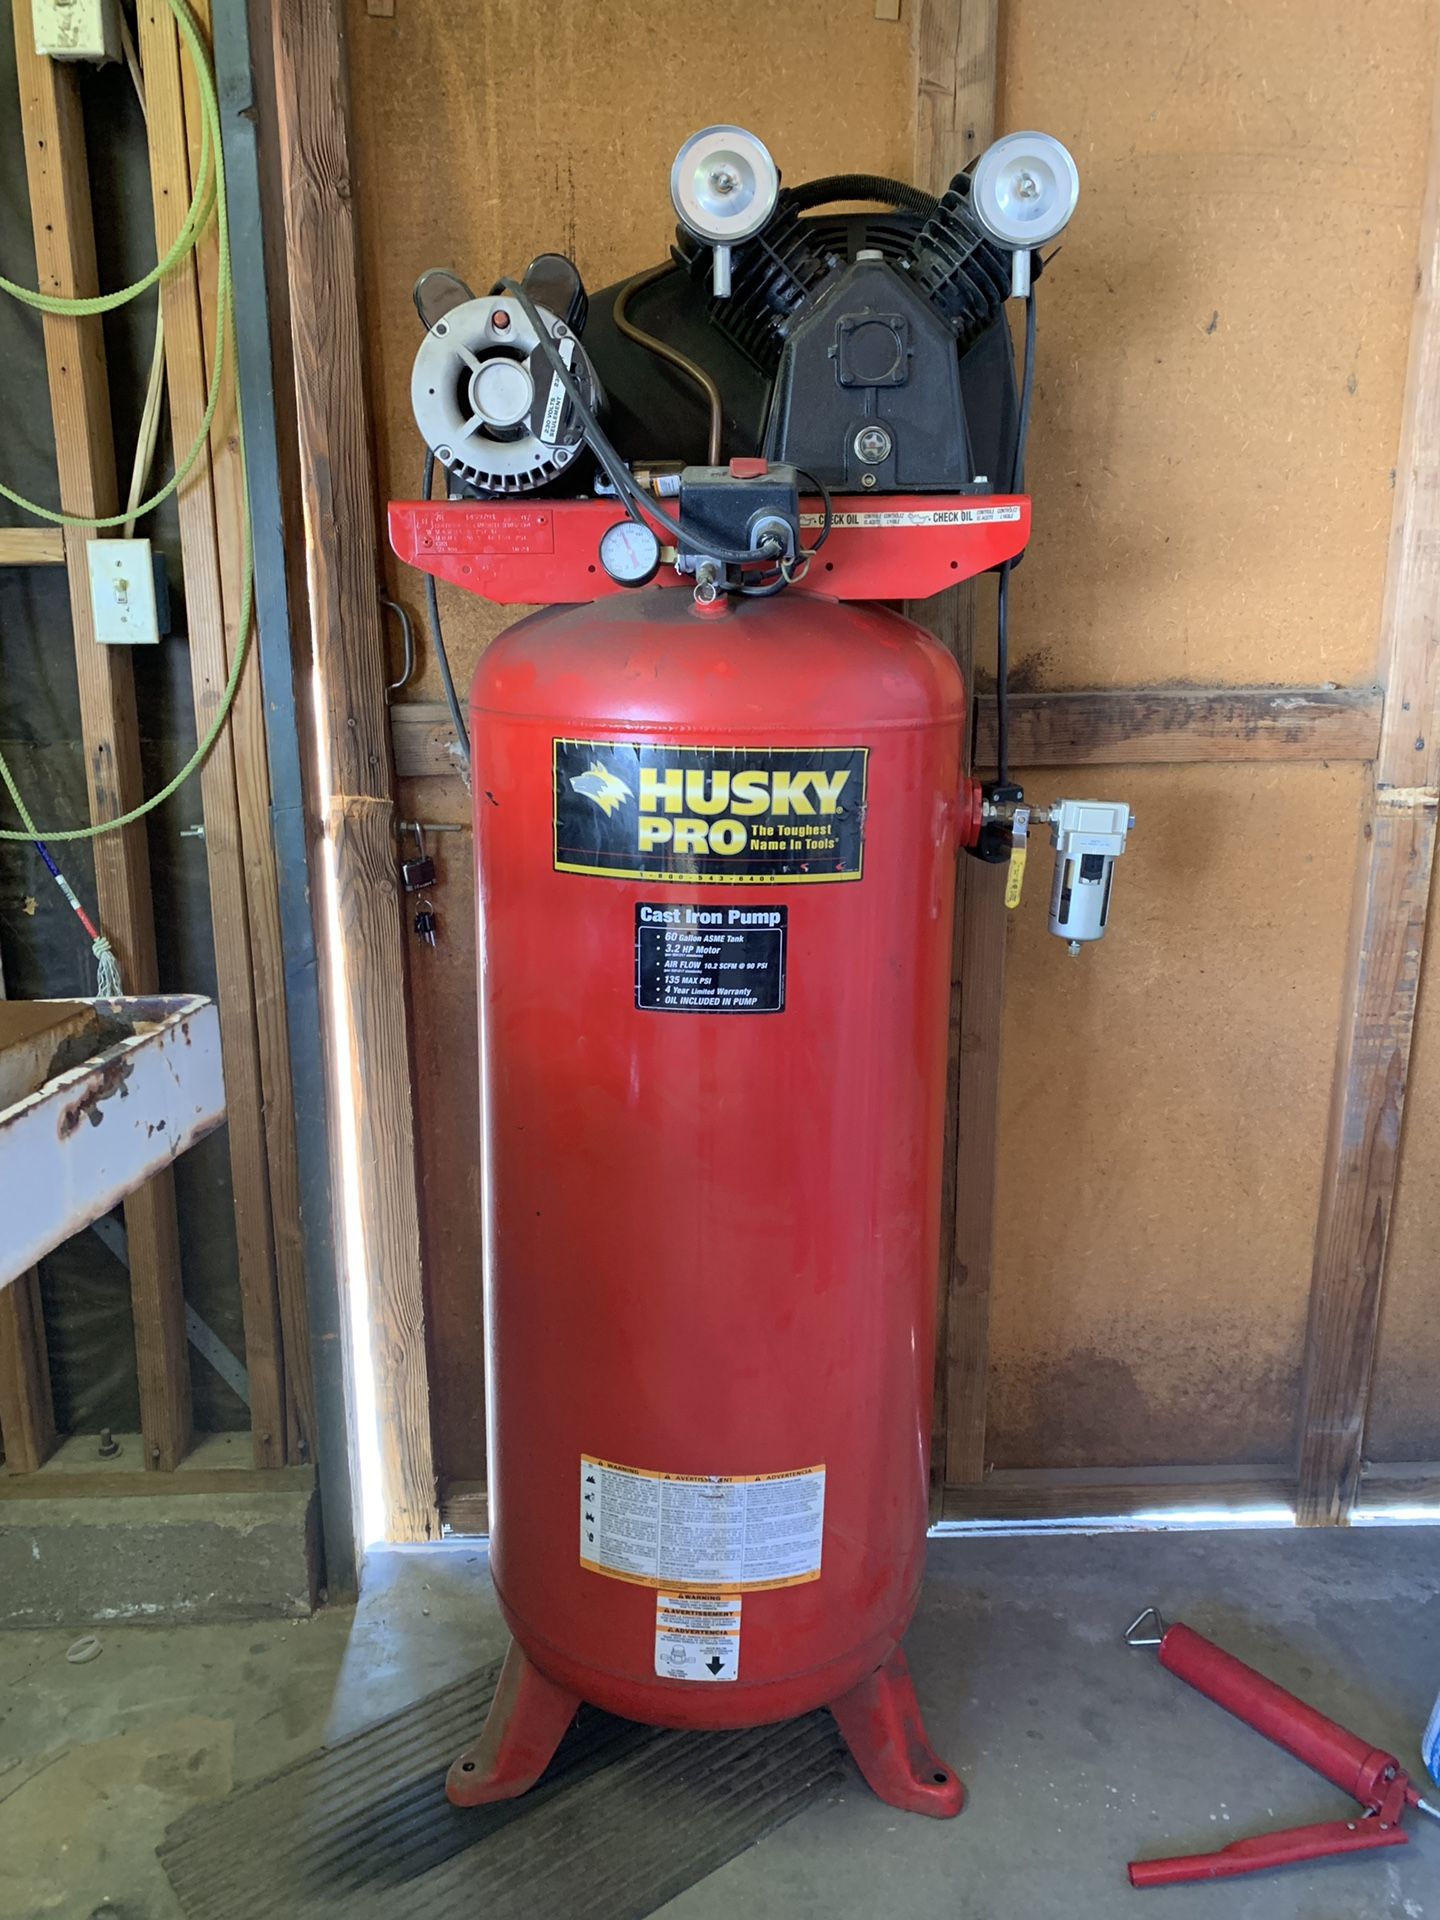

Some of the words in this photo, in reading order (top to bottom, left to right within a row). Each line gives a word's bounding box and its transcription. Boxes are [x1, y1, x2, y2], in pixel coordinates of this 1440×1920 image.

[547, 398, 555, 418] VOLTS
[549, 397, 561, 437] SEULEMENT
[819, 514, 844, 524] CECK
[846, 514, 859, 524] OIL
[933, 511, 959, 522] CHECK
[961, 511, 973, 521] OIL
[638, 815, 747, 855] PRO
[751, 824, 774, 836] The
[778, 824, 831, 838] Toughest
[750, 839, 786, 850] Name
[790, 838, 802, 850] In
[806, 838, 834, 849] Tools
[640, 907, 680, 923] Cast
[686, 909, 722, 924] Iron
[728, 910, 780, 927] Pump
[665, 932, 678, 942] 60
[679, 934, 702, 942] Gallon
[703, 935, 725, 943] ASME
[727, 935, 744, 943] Tank
[665, 944, 681, 953] 3.2
[682, 945, 694, 953] HP
[695, 946, 721, 955] Motor
[664, 960, 678, 969] AIR
[679, 961, 702, 969] FLOW
[664, 976, 680, 984] 135
[665, 985, 671, 993] 4
[673, 986, 690, 994] Year
[717, 988, 752, 997] Warranty
[664, 996, 678, 1004] OIL
[680, 997, 720, 1005] INCLUDED
[722, 997, 732, 1005] IN
[733, 997, 757, 1006] PUMP
[607, 1463, 639, 1475] WARNING
[766, 1468, 813, 1480] ADVERTENCIA
[671, 1608, 734, 1617] AVERTISSEMENT
